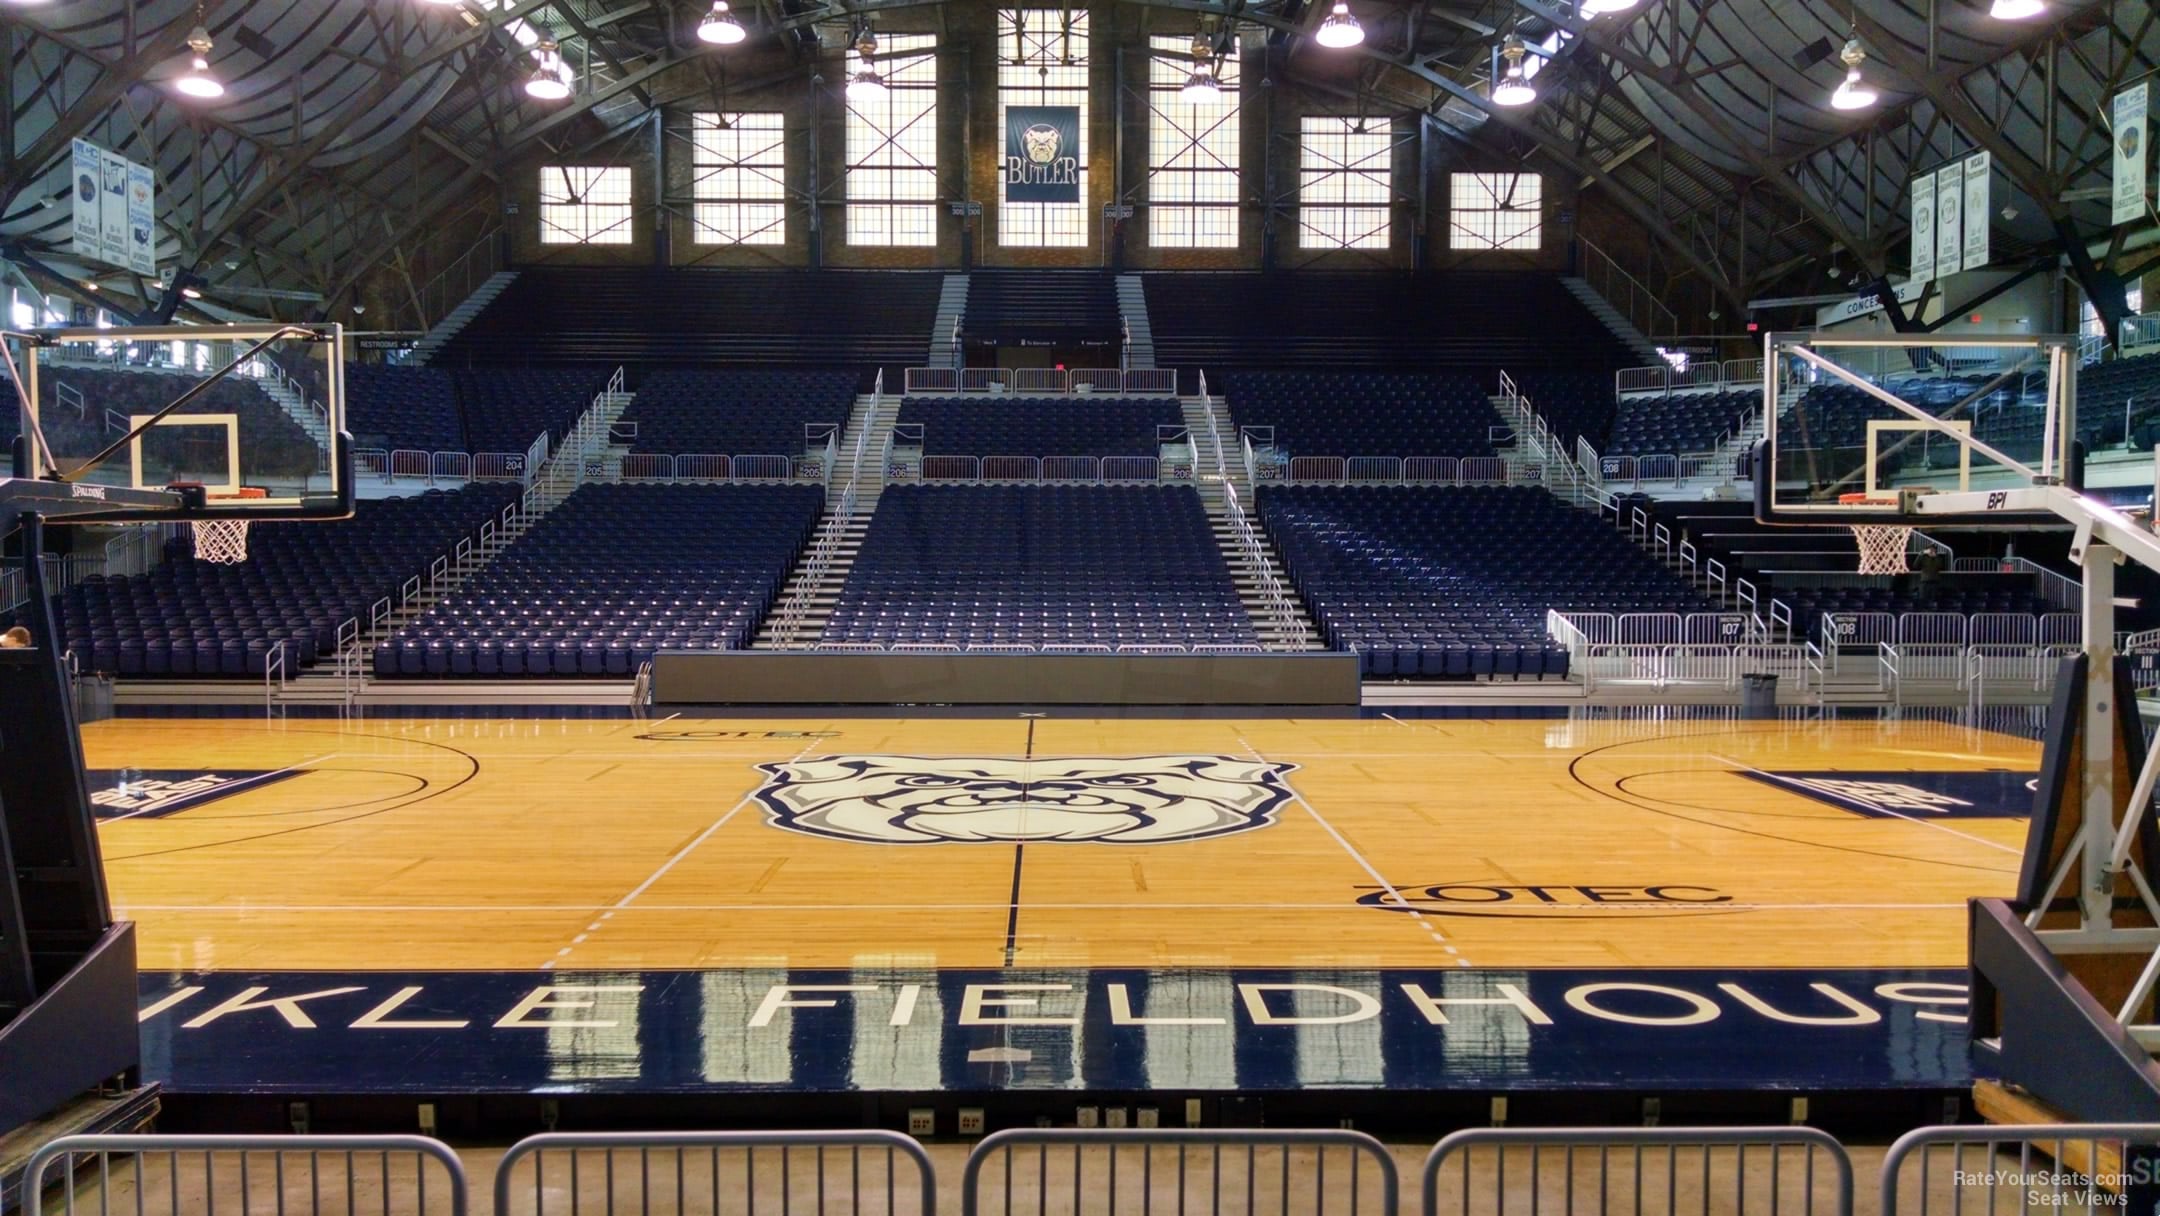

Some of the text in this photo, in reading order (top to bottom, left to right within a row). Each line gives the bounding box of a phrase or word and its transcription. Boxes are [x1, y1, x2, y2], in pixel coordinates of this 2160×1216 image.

[1007, 156, 1077, 184] BUTLER
[1847, 288, 1905, 314] CONCESNS
[505, 460, 522, 471] 204
[586, 466, 602, 476] 205
[1603, 464, 1620, 473] 208
[804, 468, 820, 478] 205
[890, 468, 906, 478] 206
[1260, 469, 1275, 479] 207
[1525, 470, 1541, 479] 207
[72, 485, 105, 500] SPALDING
[1987, 491, 2008, 510] BPI
[1722, 623, 1740, 635] 107
[1838, 623, 1856, 635] 108
[2141, 655, 2153, 669] 111
[1353, 884, 1734, 912] ZOTEC
[748, 984, 1968, 1026] FIELDHOUS
